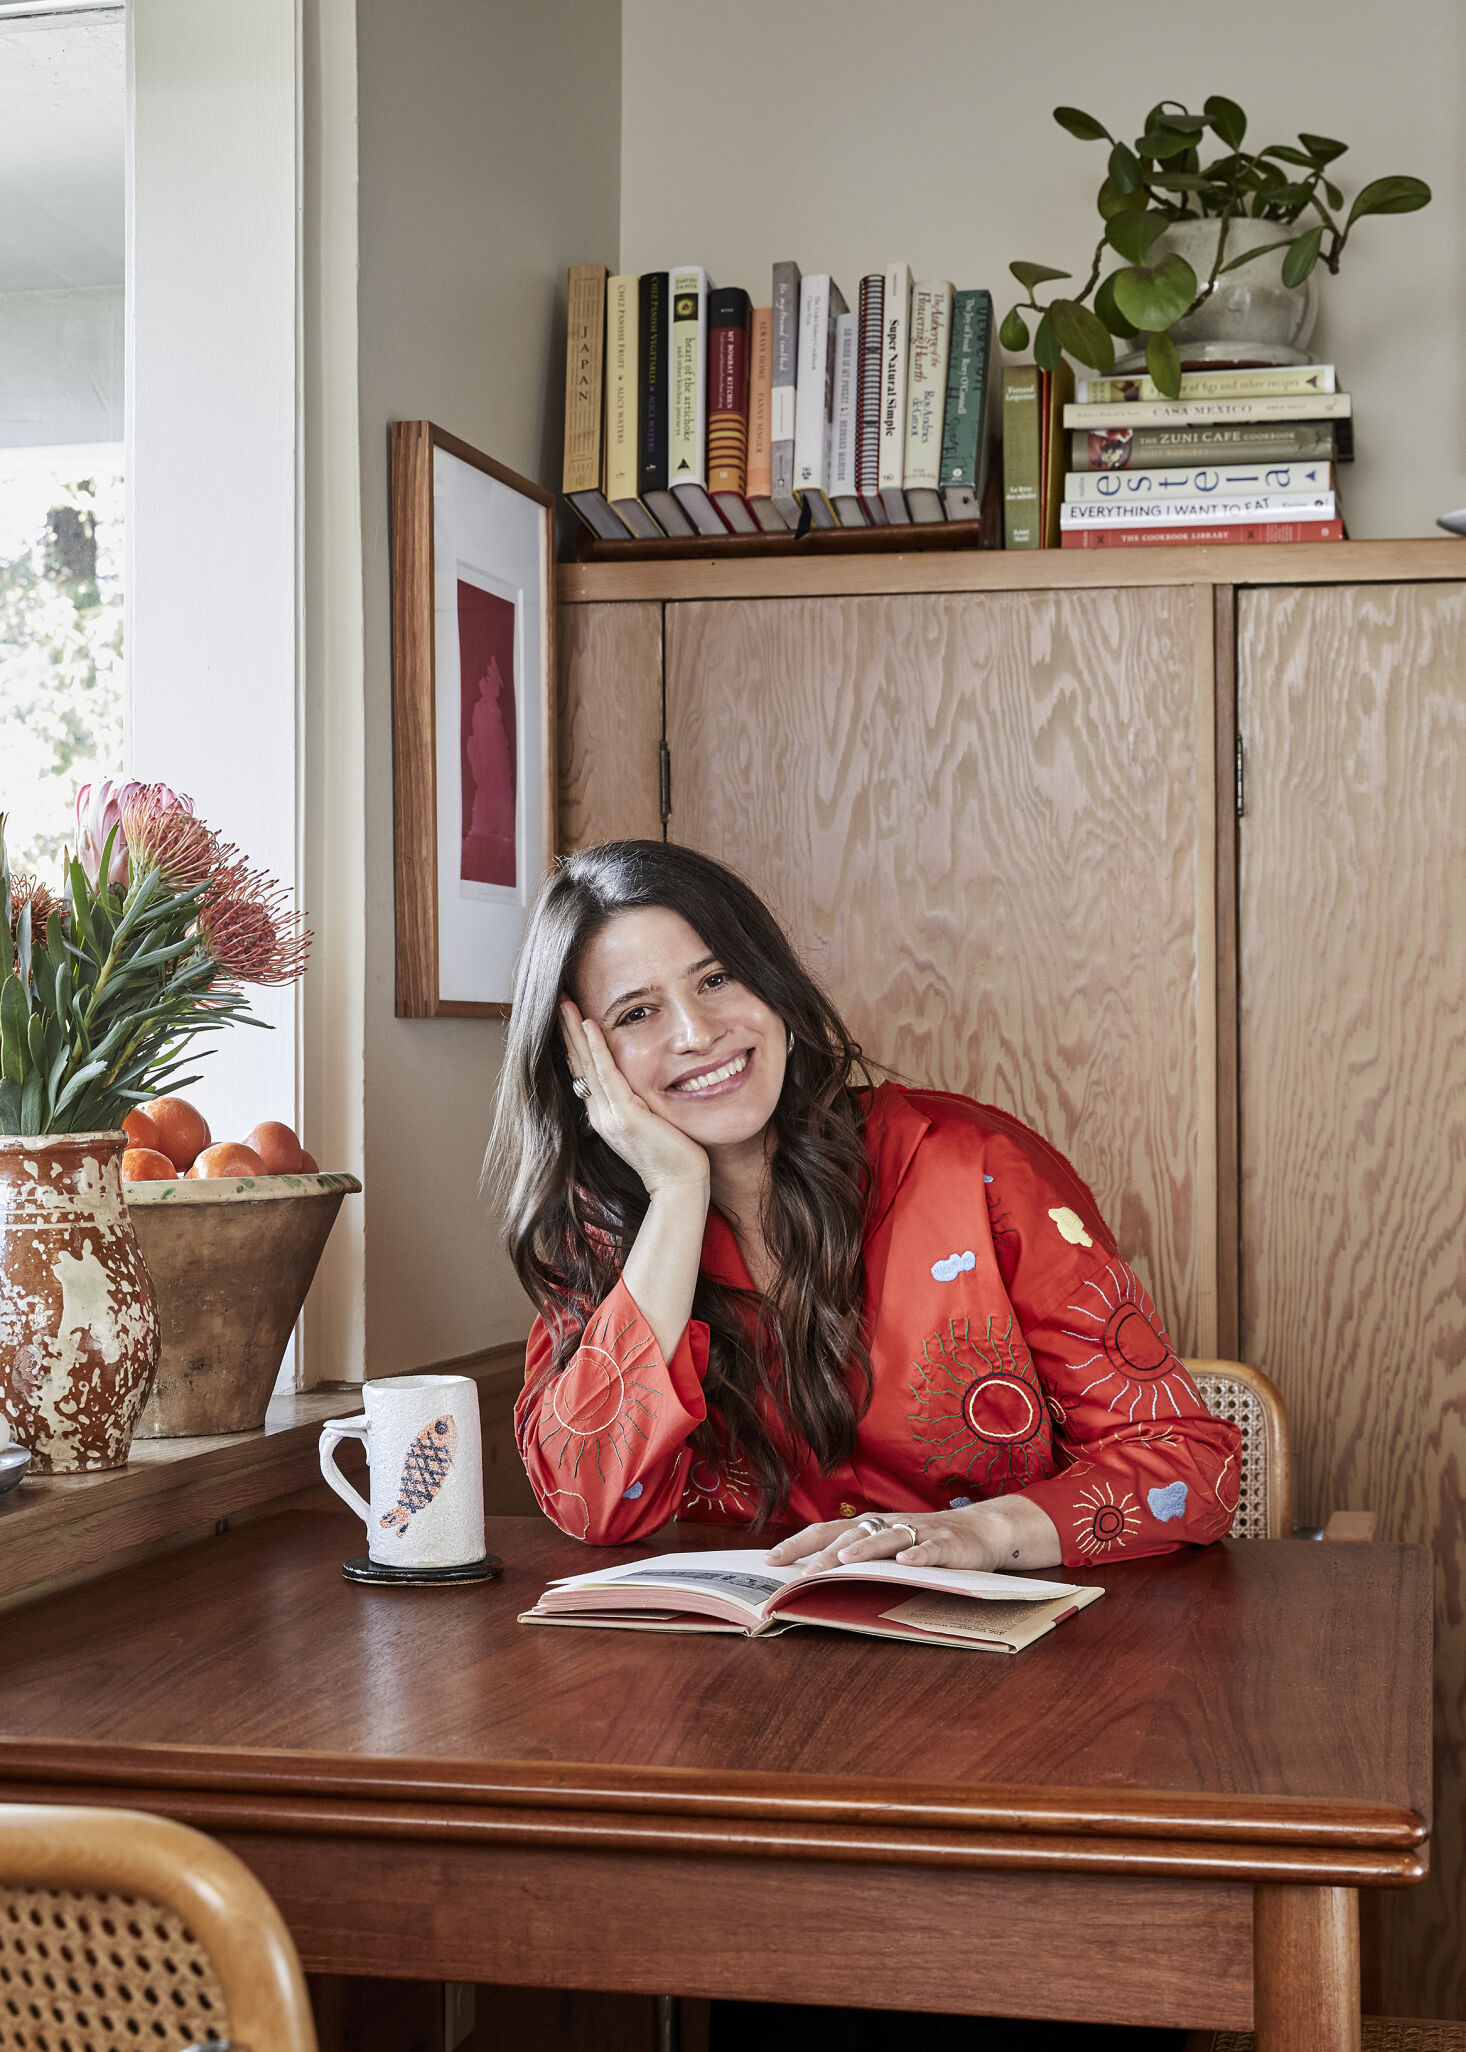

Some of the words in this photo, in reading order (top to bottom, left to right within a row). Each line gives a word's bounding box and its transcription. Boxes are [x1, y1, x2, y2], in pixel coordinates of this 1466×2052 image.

[617, 284, 626, 307] CHEZ
[651, 277, 659, 299] CHEZ
[650, 301, 658, 333] PANISSE
[966, 298, 975, 311] The
[617, 309, 625, 341] PANISSE
[911, 291, 930, 346] Flowering
[963, 312, 974, 324] Joy
[964, 324, 972, 332] of
[728, 331, 735, 341] MY
[888, 319, 899, 351] Super
[963, 333, 972, 352] Food
[578, 326, 590, 401] JAPAN
[649, 334, 657, 384] VEGETABLES
[684, 338, 695, 364] heart
[913, 345, 928, 383] Hearth
[684, 365, 695, 375] of
[887, 353, 898, 396] Natural
[675, 379, 683, 405] kitchen
[684, 377, 694, 393] the
[726, 376, 734, 409] KITCHEN
[1190, 380, 1199, 392] of
[1202, 379, 1218, 395] figs
[1221, 378, 1237, 391] and
[1239, 377, 1264, 389] other
[1267, 377, 1299, 392] recipes
[648, 395, 656, 420] ALICE
[922, 391, 934, 406] Roy
[1153, 406, 1188, 416] CASA
[1194, 404, 1252, 415] MEXICO
[674, 406, 682, 437] journeys
[683, 395, 694, 442] artichoke
[884, 399, 896, 437] Simple
[911, 408, 921, 437] Groot
[920, 408, 934, 444] Andries
[755, 422, 763, 453] SINGER
[1140, 437, 1157, 445] THE
[1160, 432, 1198, 444] ZUNI
[1202, 431, 1240, 442] CAFE
[1243, 432, 1295, 441] COOKBOOK
[1096, 467, 1291, 497] estela
[1070, 505, 1162, 518] EVERYTHING
[1166, 505, 1170, 515] I
[1174, 504, 1218, 516] WANT
[1223, 503, 1241, 517] TO
[1121, 534, 1139, 542] THE
[1142, 533, 1189, 542] COOKBOOK
[1191, 531, 1229, 540] LIBRARY
